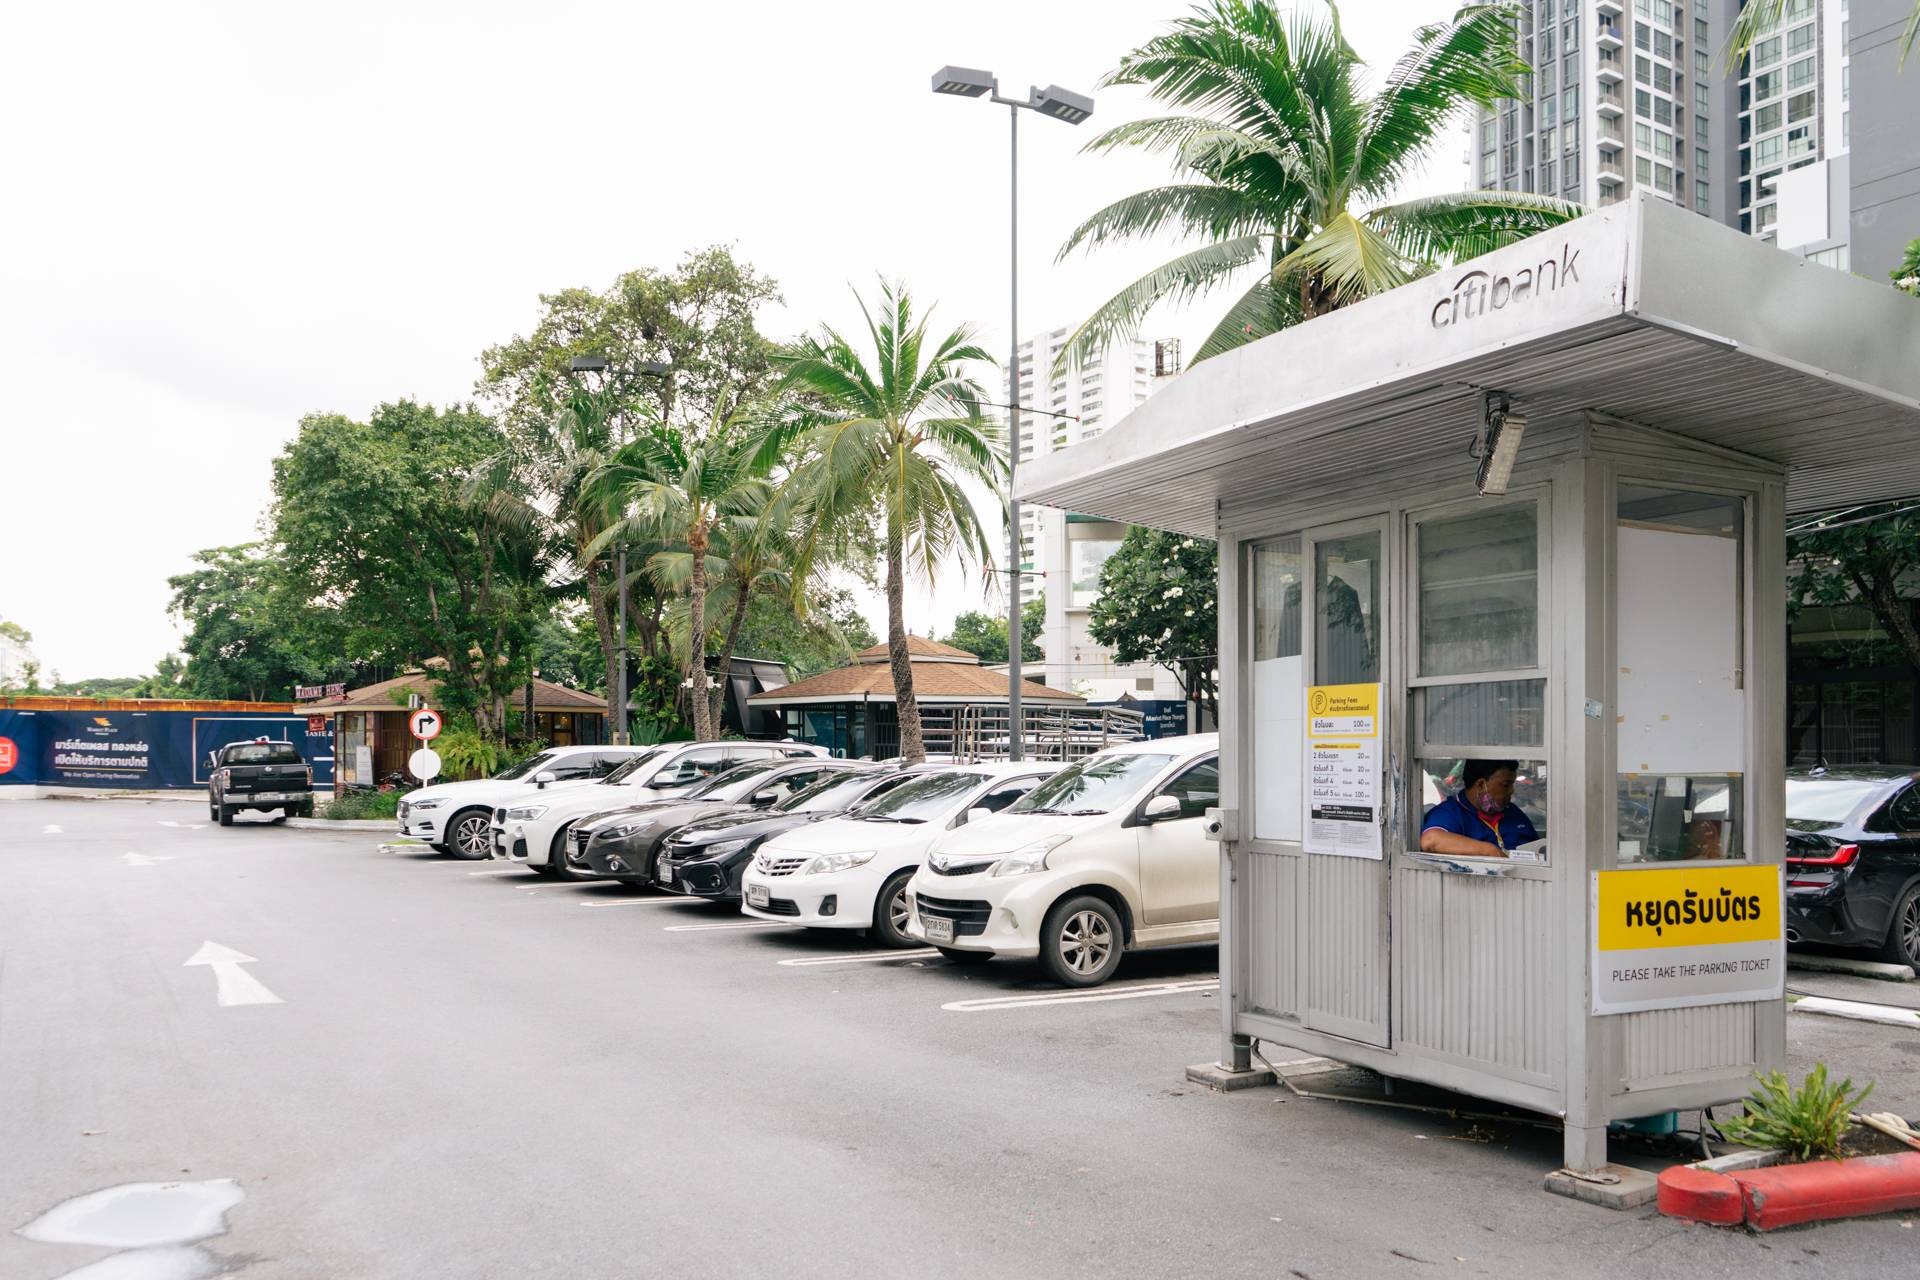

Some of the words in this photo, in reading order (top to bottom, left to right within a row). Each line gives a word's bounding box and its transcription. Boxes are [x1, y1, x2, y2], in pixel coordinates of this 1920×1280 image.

[1431, 242, 1581, 330] citibank
[1329, 697, 1347, 706] Parking
[1347, 696, 1358, 704] Fees
[1353, 719, 1364, 728] 100
[1625, 887, 1761, 937] หยุดรับบัตร
[1612, 967, 1650, 982] PLEASE
[1653, 966, 1676, 980] TAKE
[1679, 964, 1696, 978] THE
[1699, 961, 1738, 976] PARKING
[1740, 958, 1771, 972] TICKET
